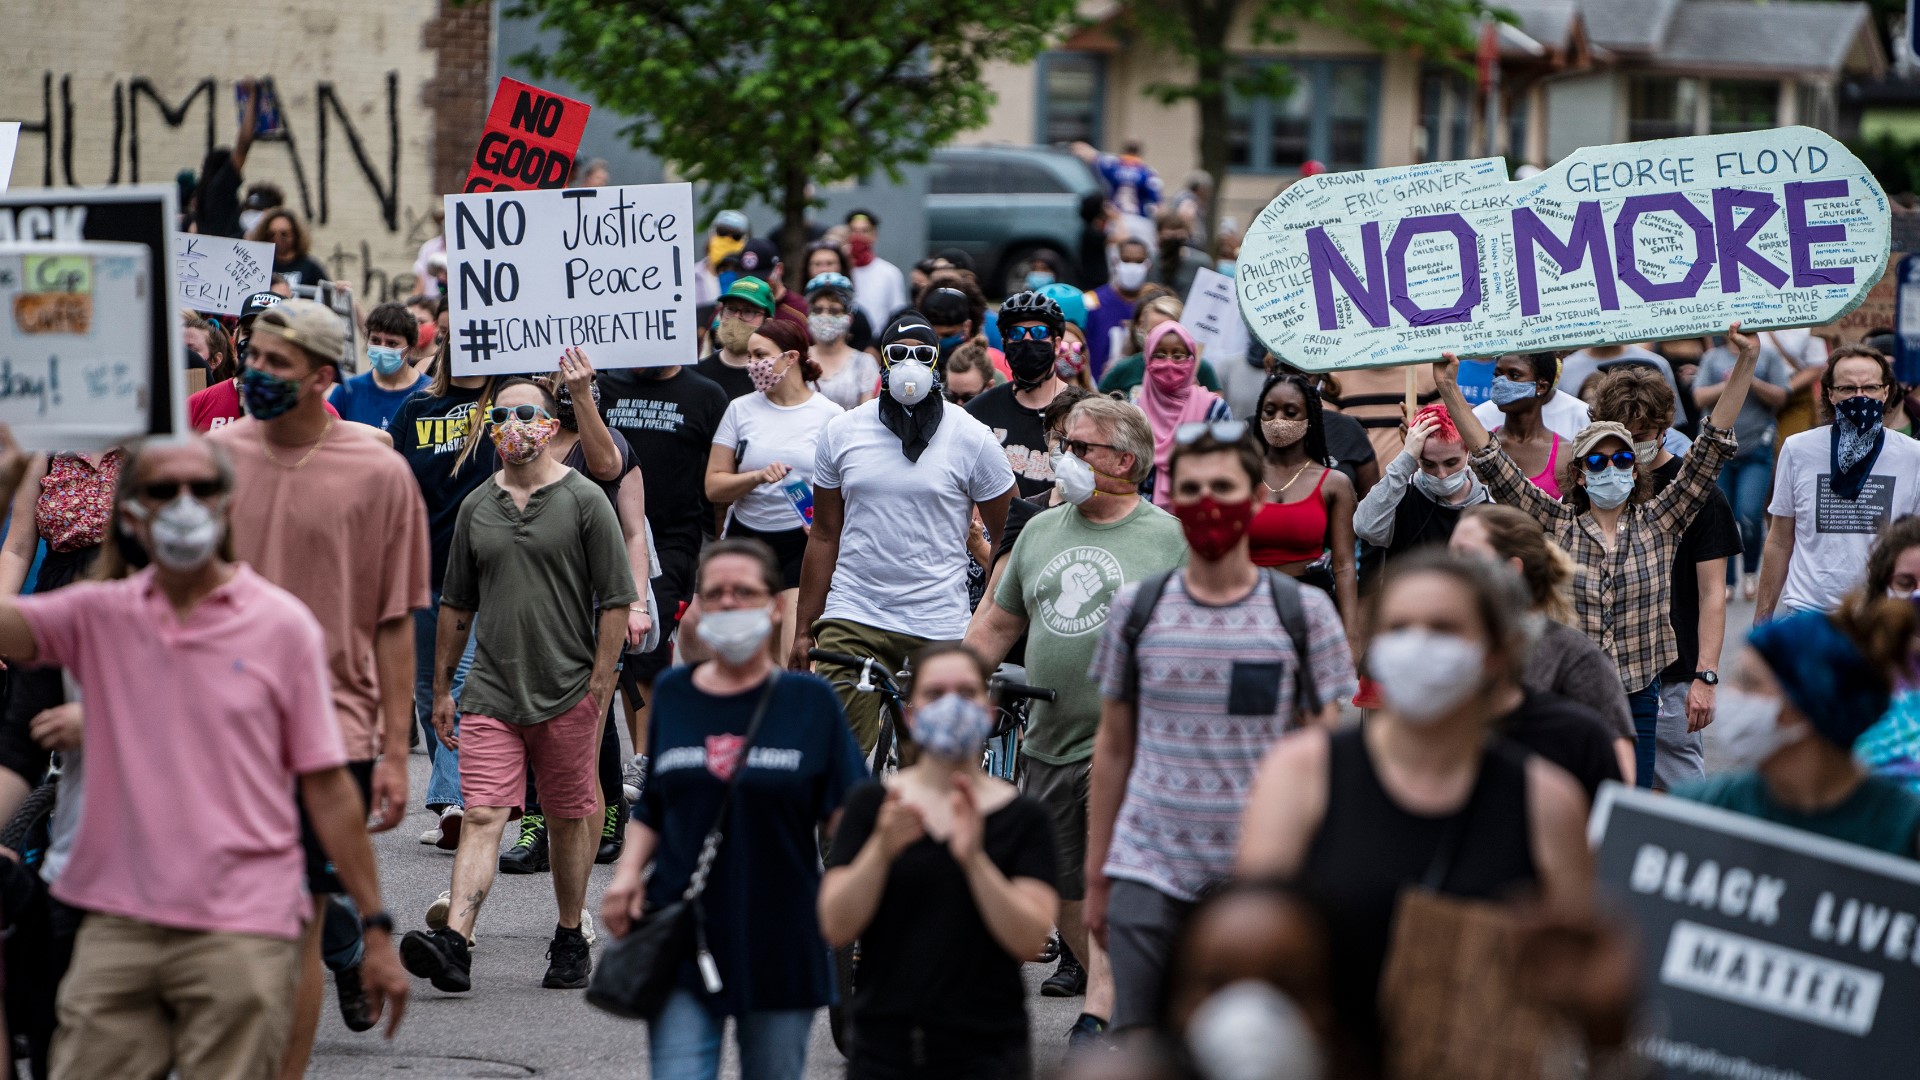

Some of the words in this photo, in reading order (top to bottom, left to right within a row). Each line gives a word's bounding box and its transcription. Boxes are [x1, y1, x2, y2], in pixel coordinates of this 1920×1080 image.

[509, 90, 564, 138] NO
[476, 131, 571, 189] GOOD
[1409, 168, 1443, 179] FRANKLIN
[1566, 157, 1695, 193] GEORGE
[1716, 147, 1829, 178] FLOYD
[1344, 189, 1389, 216] ERIC
[1393, 171, 1472, 202] GARNER
[1860, 176, 1879, 197] ANTWON
[1260, 184, 1315, 230] MICHAEL
[1316, 172, 1366, 190] BROWN
[1404, 200, 1457, 218] JAMAR
[1460, 194, 1514, 211] CLARK
[1533, 197, 1562, 208] JASON
[1813, 199, 1861, 210] TERENCE
[456, 198, 526, 250] NO
[562, 188, 677, 250] Justice
[1644, 213, 1682, 230] EMERSON
[1819, 209, 1865, 219] CRUTCHER
[0, 206, 87, 242] ACK
[1284, 219, 1316, 231] GREGORY
[1320, 217, 1342, 227] GUNN
[1414, 238, 1435, 248] KEITH
[1639, 236, 1676, 247] YVETTE
[1672, 230, 1684, 238] JR
[1758, 232, 1779, 241] ERIC
[1305, 213, 1481, 331] NO
[1511, 179, 1856, 318] MORE
[1327, 229, 1346, 253] VICTOR
[1344, 254, 1361, 275] WHITE
[1413, 243, 1454, 257] CHILDRESS
[1501, 232, 1514, 266] SCOTT
[1651, 244, 1684, 255] SMITH
[236, 260, 254, 279] THE
[1242, 252, 1310, 281] PHILANDO
[1407, 261, 1444, 273] BRENDAN
[1427, 265, 1453, 275] GLENN
[1637, 259, 1665, 271] TOMMY
[1813, 258, 1837, 269] AKAI
[1839, 254, 1879, 266] GURLEY
[225, 263, 251, 295] LOVE?
[1642, 267, 1667, 279] YANCY
[460, 259, 520, 310] NO
[1245, 268, 1312, 301] CASTILE
[1504, 269, 1520, 312] WALTER
[1571, 280, 1596, 290] KING
[1481, 277, 1491, 313] JORDAN
[1774, 289, 1823, 305] TAMIR
[1260, 305, 1296, 327] JERAME
[1335, 296, 1346, 330] ROBERT
[1650, 306, 1678, 319] SAM
[1679, 301, 1726, 316] DUBOSE
[1787, 300, 1819, 315] RICE
[1283, 313, 1305, 329] REID
[1521, 314, 1553, 329] ALTON
[1555, 307, 1601, 322] STERLING
[1302, 333, 1343, 346] FREDDIE
[1397, 325, 1442, 343] JEREMY
[1444, 320, 1487, 334] MCDOLE
[1463, 330, 1493, 342] BETTIE
[1496, 328, 1523, 337] JONES
[1516, 337, 1548, 350] MICHAEL
[1561, 328, 1606, 340] MARSHALL
[1613, 326, 1659, 342] WILLIAM
[1660, 320, 1710, 336] CHAPMAN
[1303, 345, 1331, 356] GRAY
[1391, 343, 1410, 353] HALL
[616, 399, 630, 408] OUR
[631, 399, 647, 409] KIDS
[648, 400, 663, 410] ARE
[663, 402, 678, 411] NOT
[606, 408, 638, 418] ENTERING
[639, 409, 657, 418] YOUR
[657, 410, 684, 424] SCHOOL
[609, 418, 617, 427] TO
[618, 418, 643, 428] PRISON
[1045, 552, 1072, 577] FIGHT
[1075, 549, 1120, 581] IGNORANCE
[1041, 598, 1056, 619] NOT
[1050, 602, 1111, 632] IMMIGRANTS
[1630, 844, 1786, 926] BLACK
[1691, 941, 1860, 1014] MATTER
